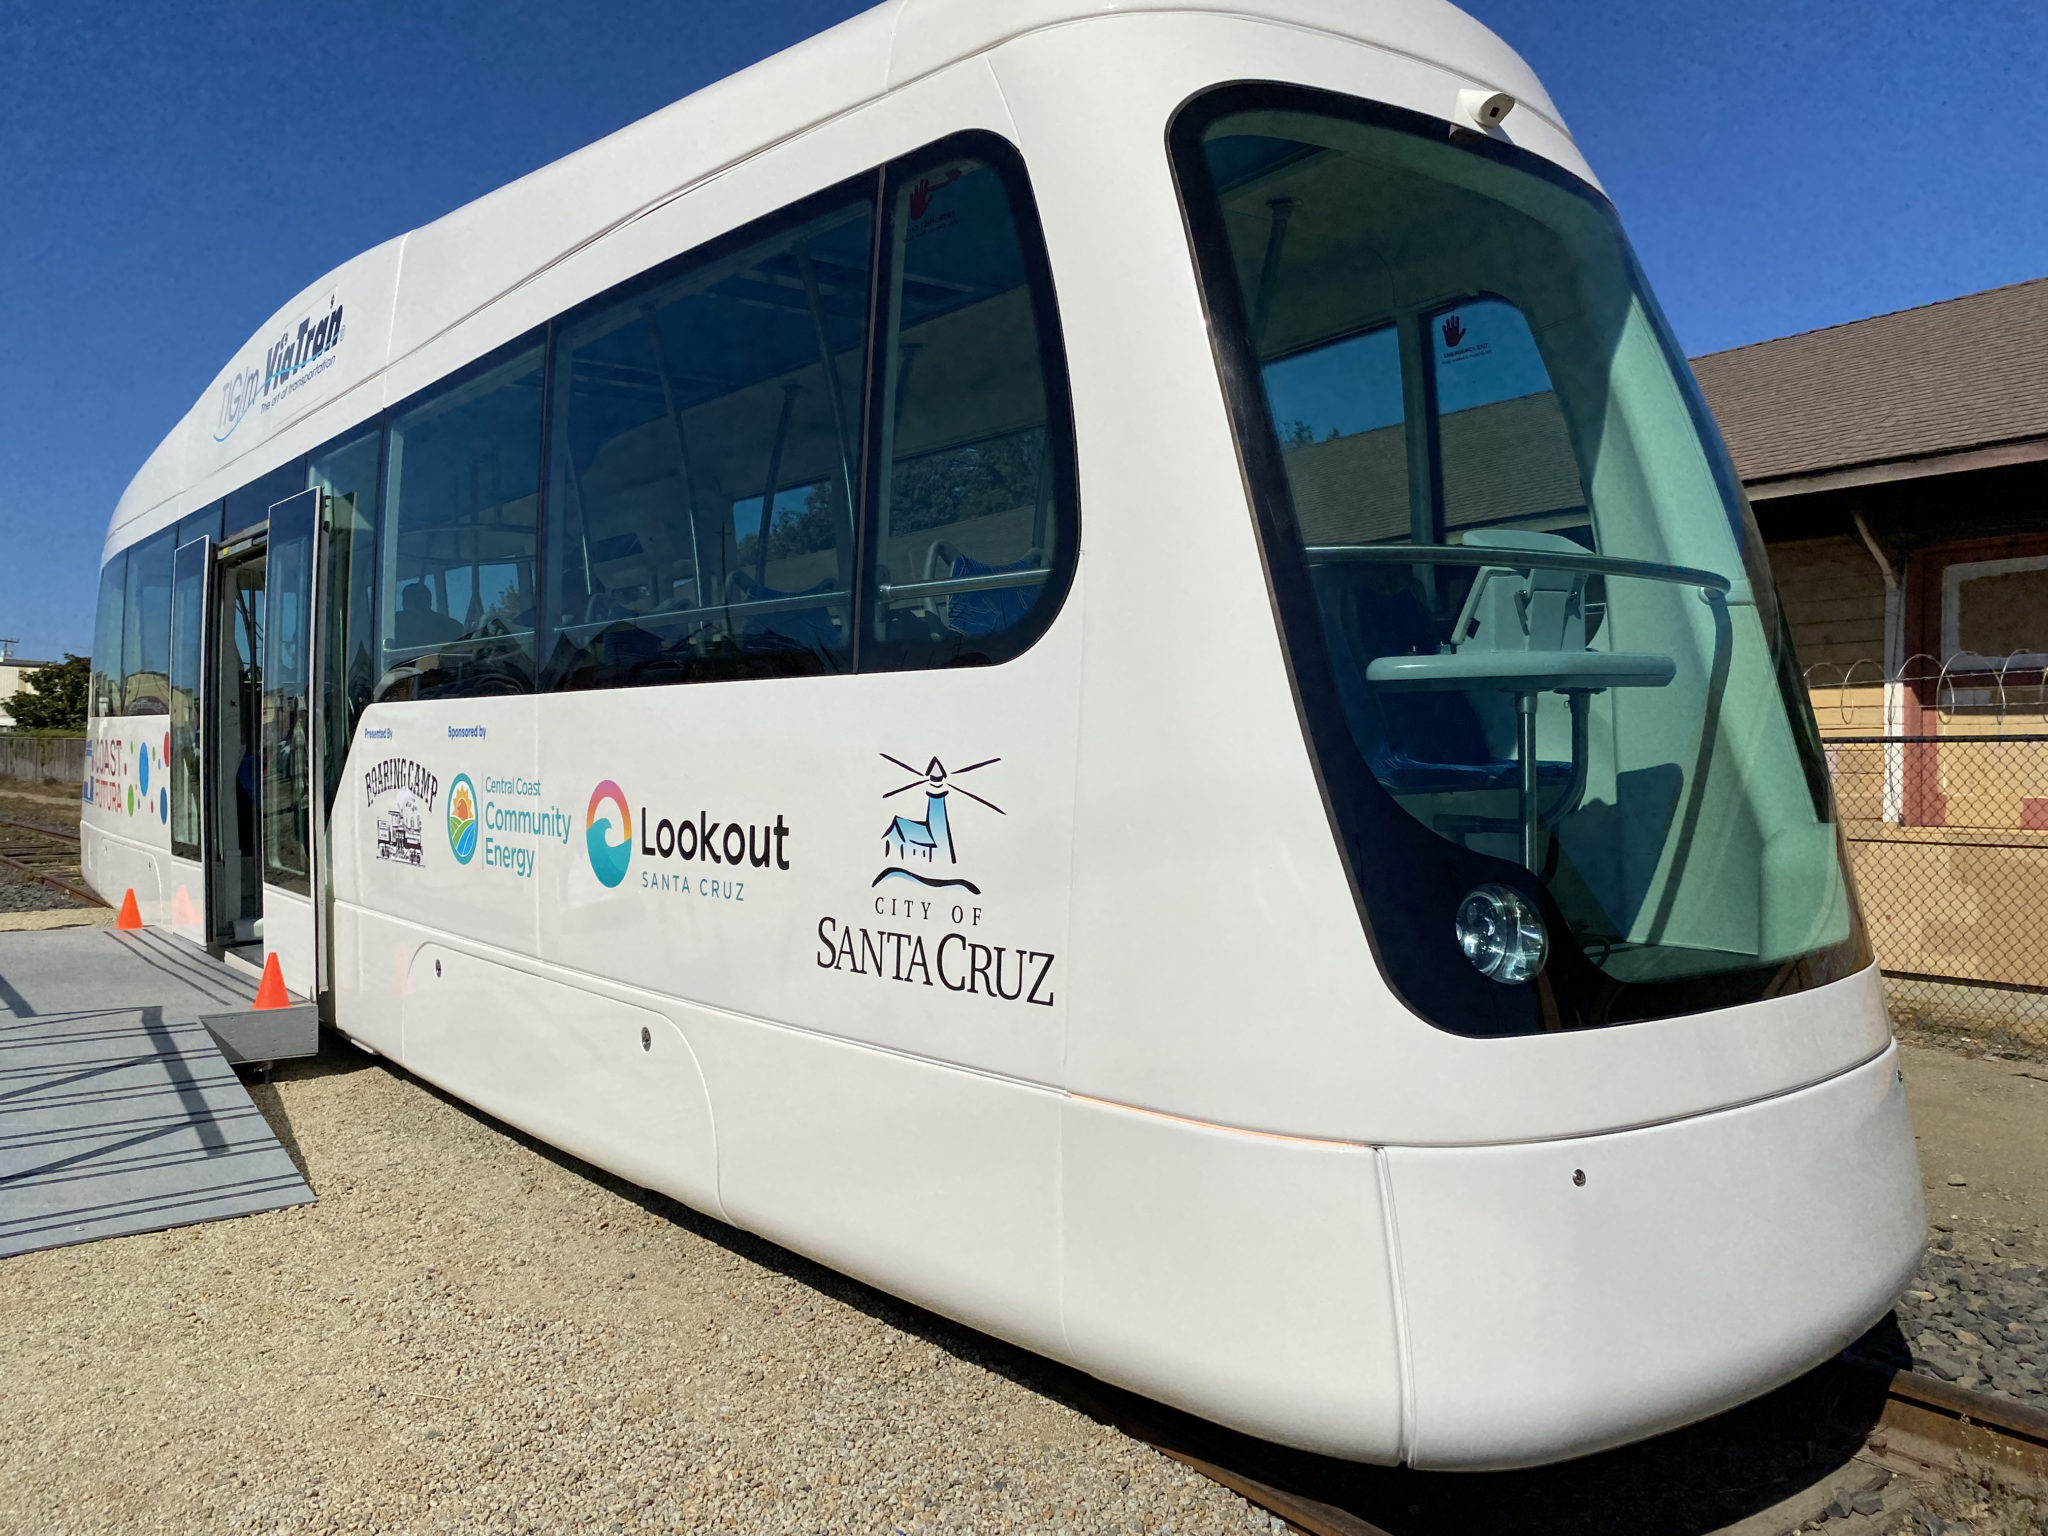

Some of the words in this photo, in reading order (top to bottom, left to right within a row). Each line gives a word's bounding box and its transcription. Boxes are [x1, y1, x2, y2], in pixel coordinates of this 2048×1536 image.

[288, 355, 336, 394] transportation
[365, 728, 386, 739] Presented
[387, 728, 393, 740] By
[448, 725, 478, 740] Sponsored
[479, 724, 486, 740] by
[365, 758, 406, 807] ROARING
[407, 760, 438, 813] CAMP
[485, 776, 514, 795] Central
[516, 777, 541, 796] Coast
[485, 801, 572, 844] Community
[642, 807, 790, 871] Lookout
[485, 837, 535, 878] Energy
[642, 871, 690, 894] SANTA
[700, 878, 744, 901] CRUZ
[875, 896, 931, 920] CITY
[952, 905, 982, 926] OF
[817, 916, 934, 986] SANTA
[936, 932, 1055, 1007] CRUZ
